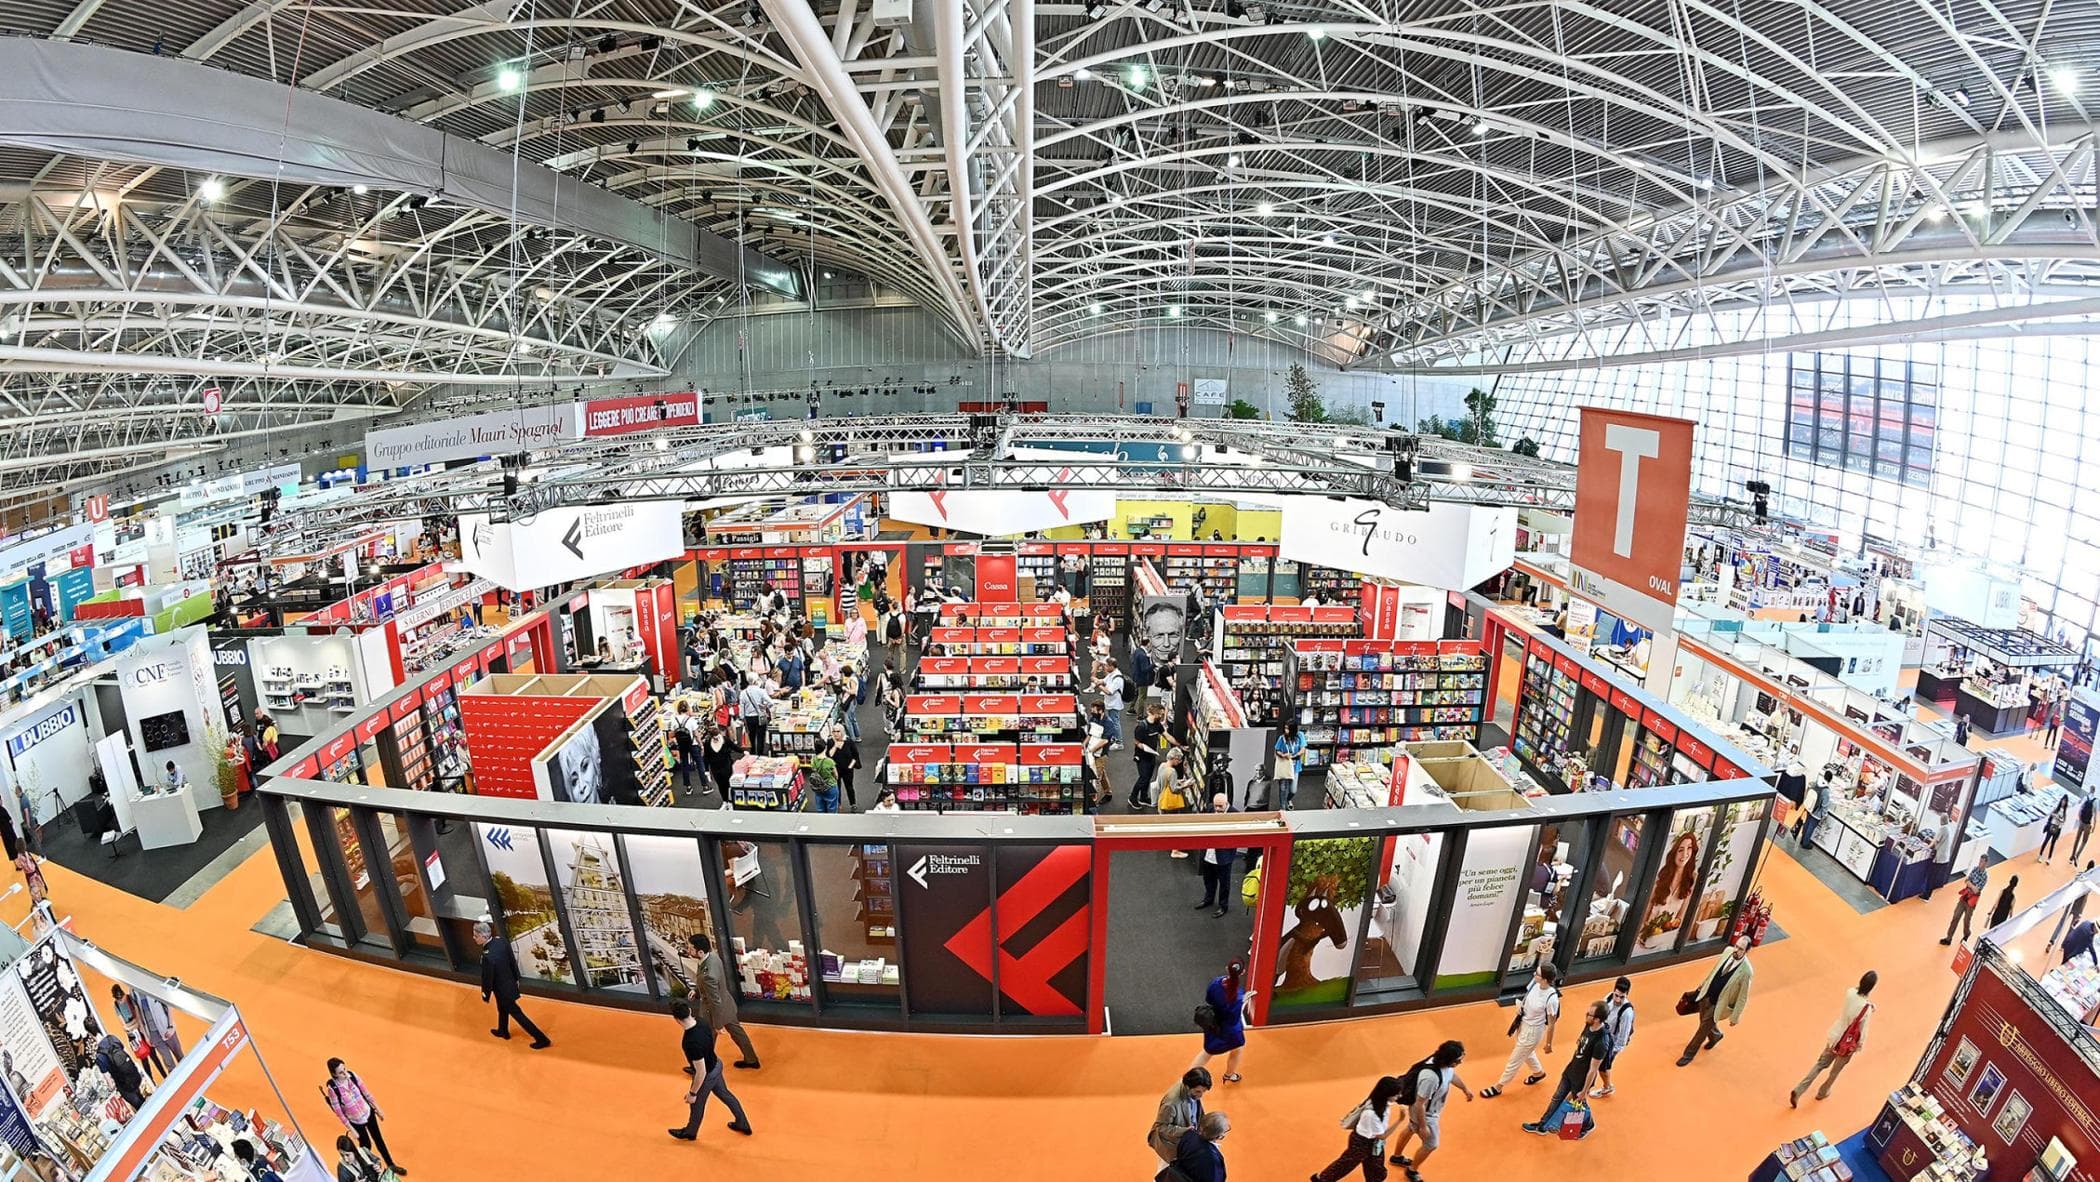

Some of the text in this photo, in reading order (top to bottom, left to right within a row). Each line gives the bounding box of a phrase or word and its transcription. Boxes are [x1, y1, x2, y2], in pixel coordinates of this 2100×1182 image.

[589, 409, 620, 430] LEGGERE
[635, 405, 658, 423] CREARE
[373, 416, 564, 461] Gruppo editoriale Mauri Spagnol
[1604, 422, 1661, 559] T
[91, 496, 104, 520] U
[584, 505, 634, 525] Feltrinelli
[585, 522, 624, 538] Editore
[1330, 521, 1418, 545] GRIBAUDO
[983, 581, 1009, 591] Cassa
[1649, 575, 1673, 597] OVAL
[403, 606, 435, 627] SALERNO
[441, 589, 470, 610] EDITRICE
[641, 600, 650, 632] Cassa
[1384, 596, 1393, 630] Cassa
[213, 649, 247, 665] UBBIO
[136, 663, 166, 684] CNF
[21, 709, 72, 750] DUBBIO
[929, 854, 981, 865] Feltrinelli
[930, 864, 969, 874] Editore
[221, 1027, 240, 1049] T53
